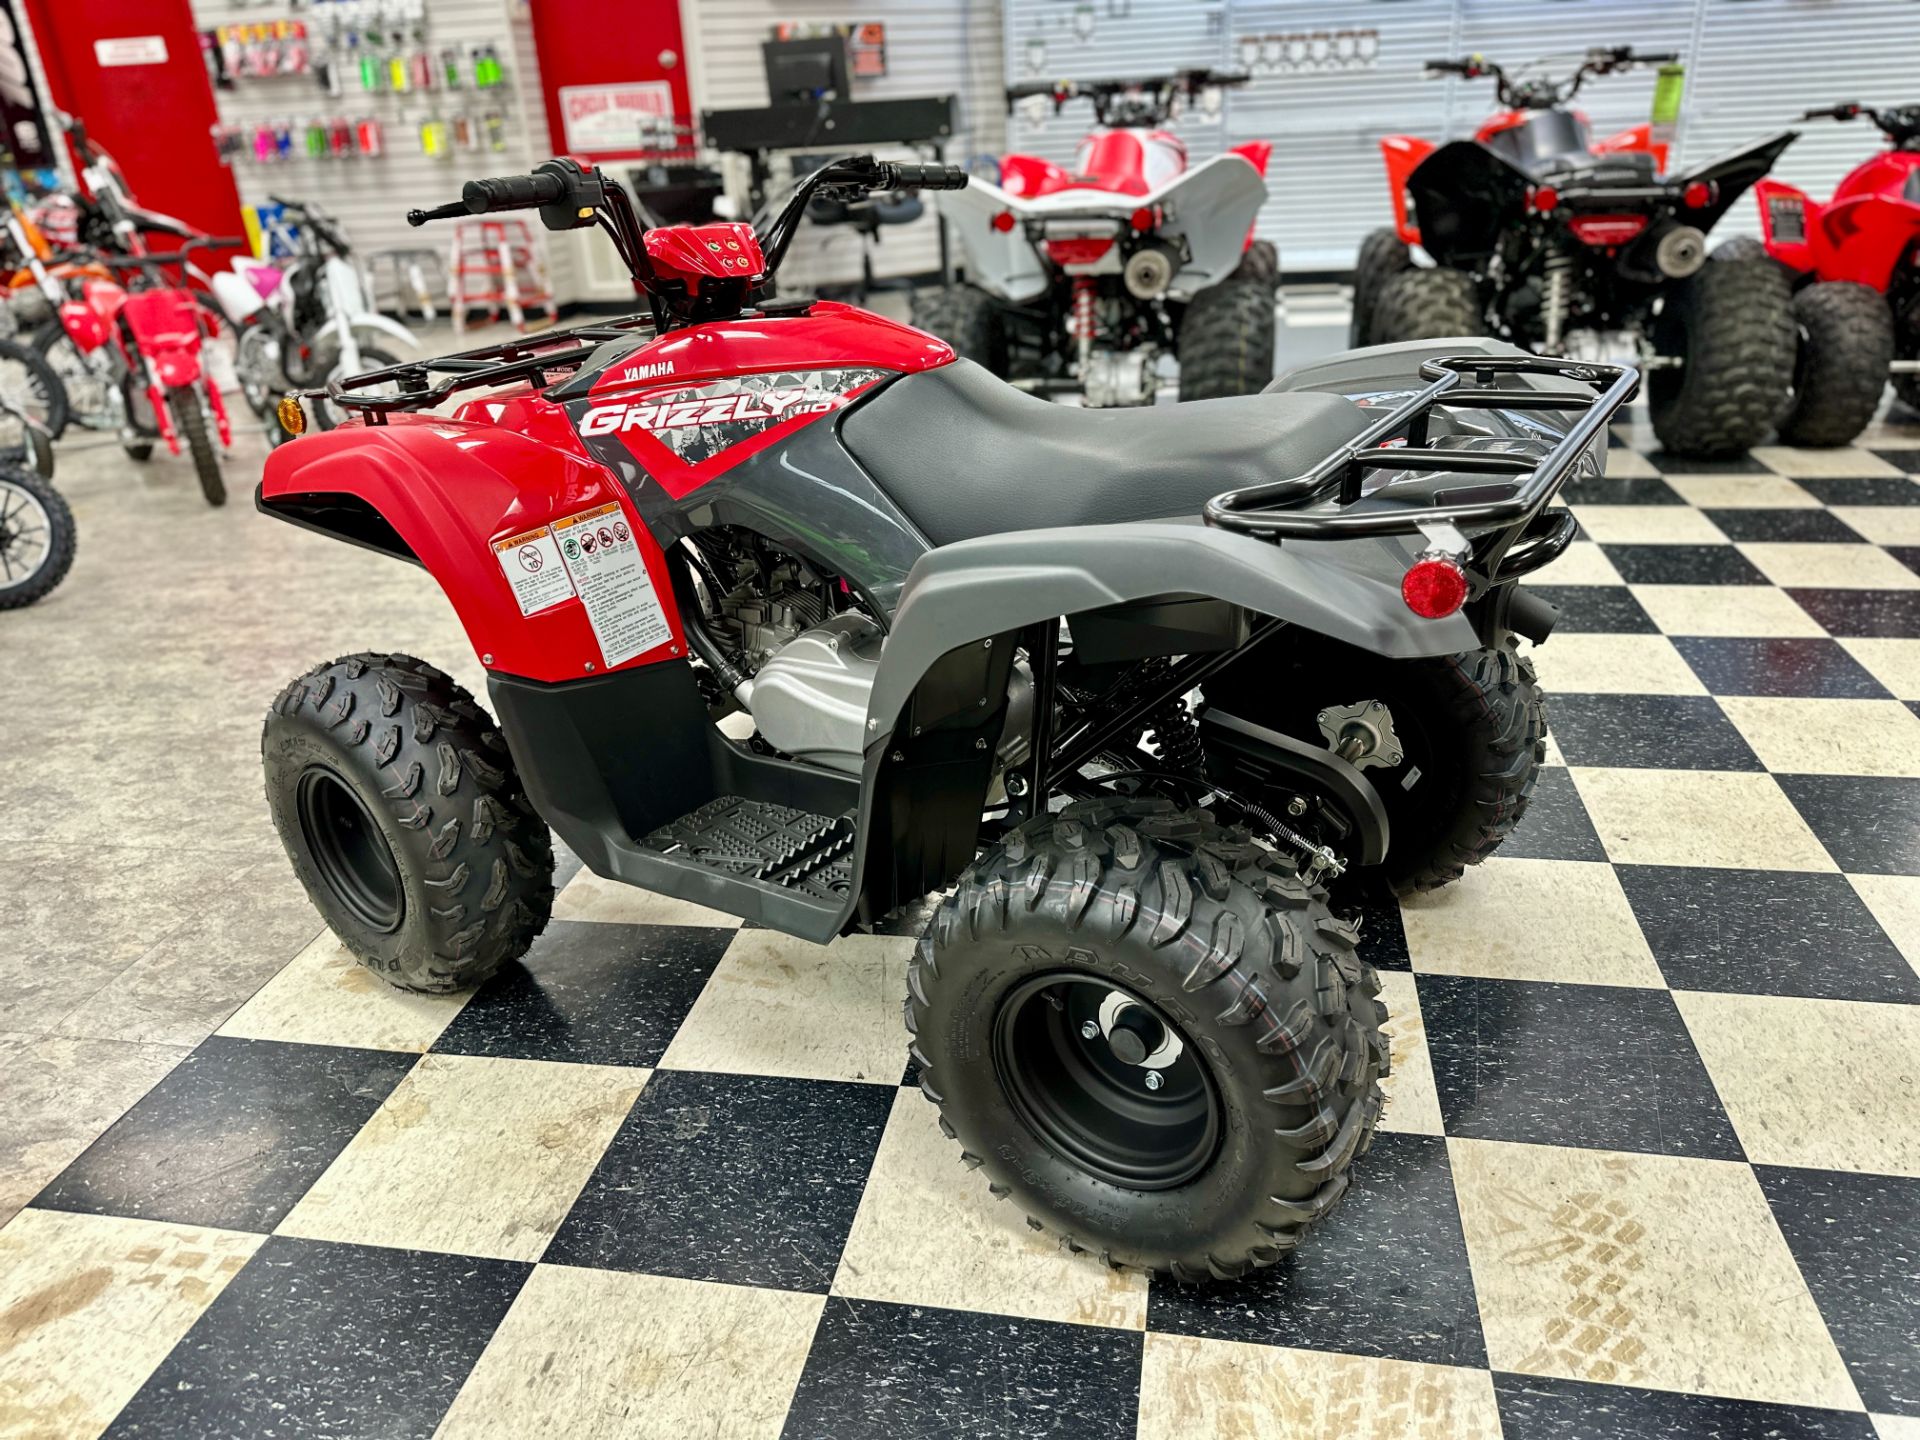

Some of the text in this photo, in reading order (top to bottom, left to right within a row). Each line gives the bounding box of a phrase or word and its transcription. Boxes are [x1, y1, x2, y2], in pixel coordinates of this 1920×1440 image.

[624, 361, 675, 381] YAMAHA
[579, 388, 832, 437] GRIZZLY 110
[578, 508, 604, 521] WARNING
[514, 533, 540, 545] WARNING
[529, 560, 539, 570] 10
